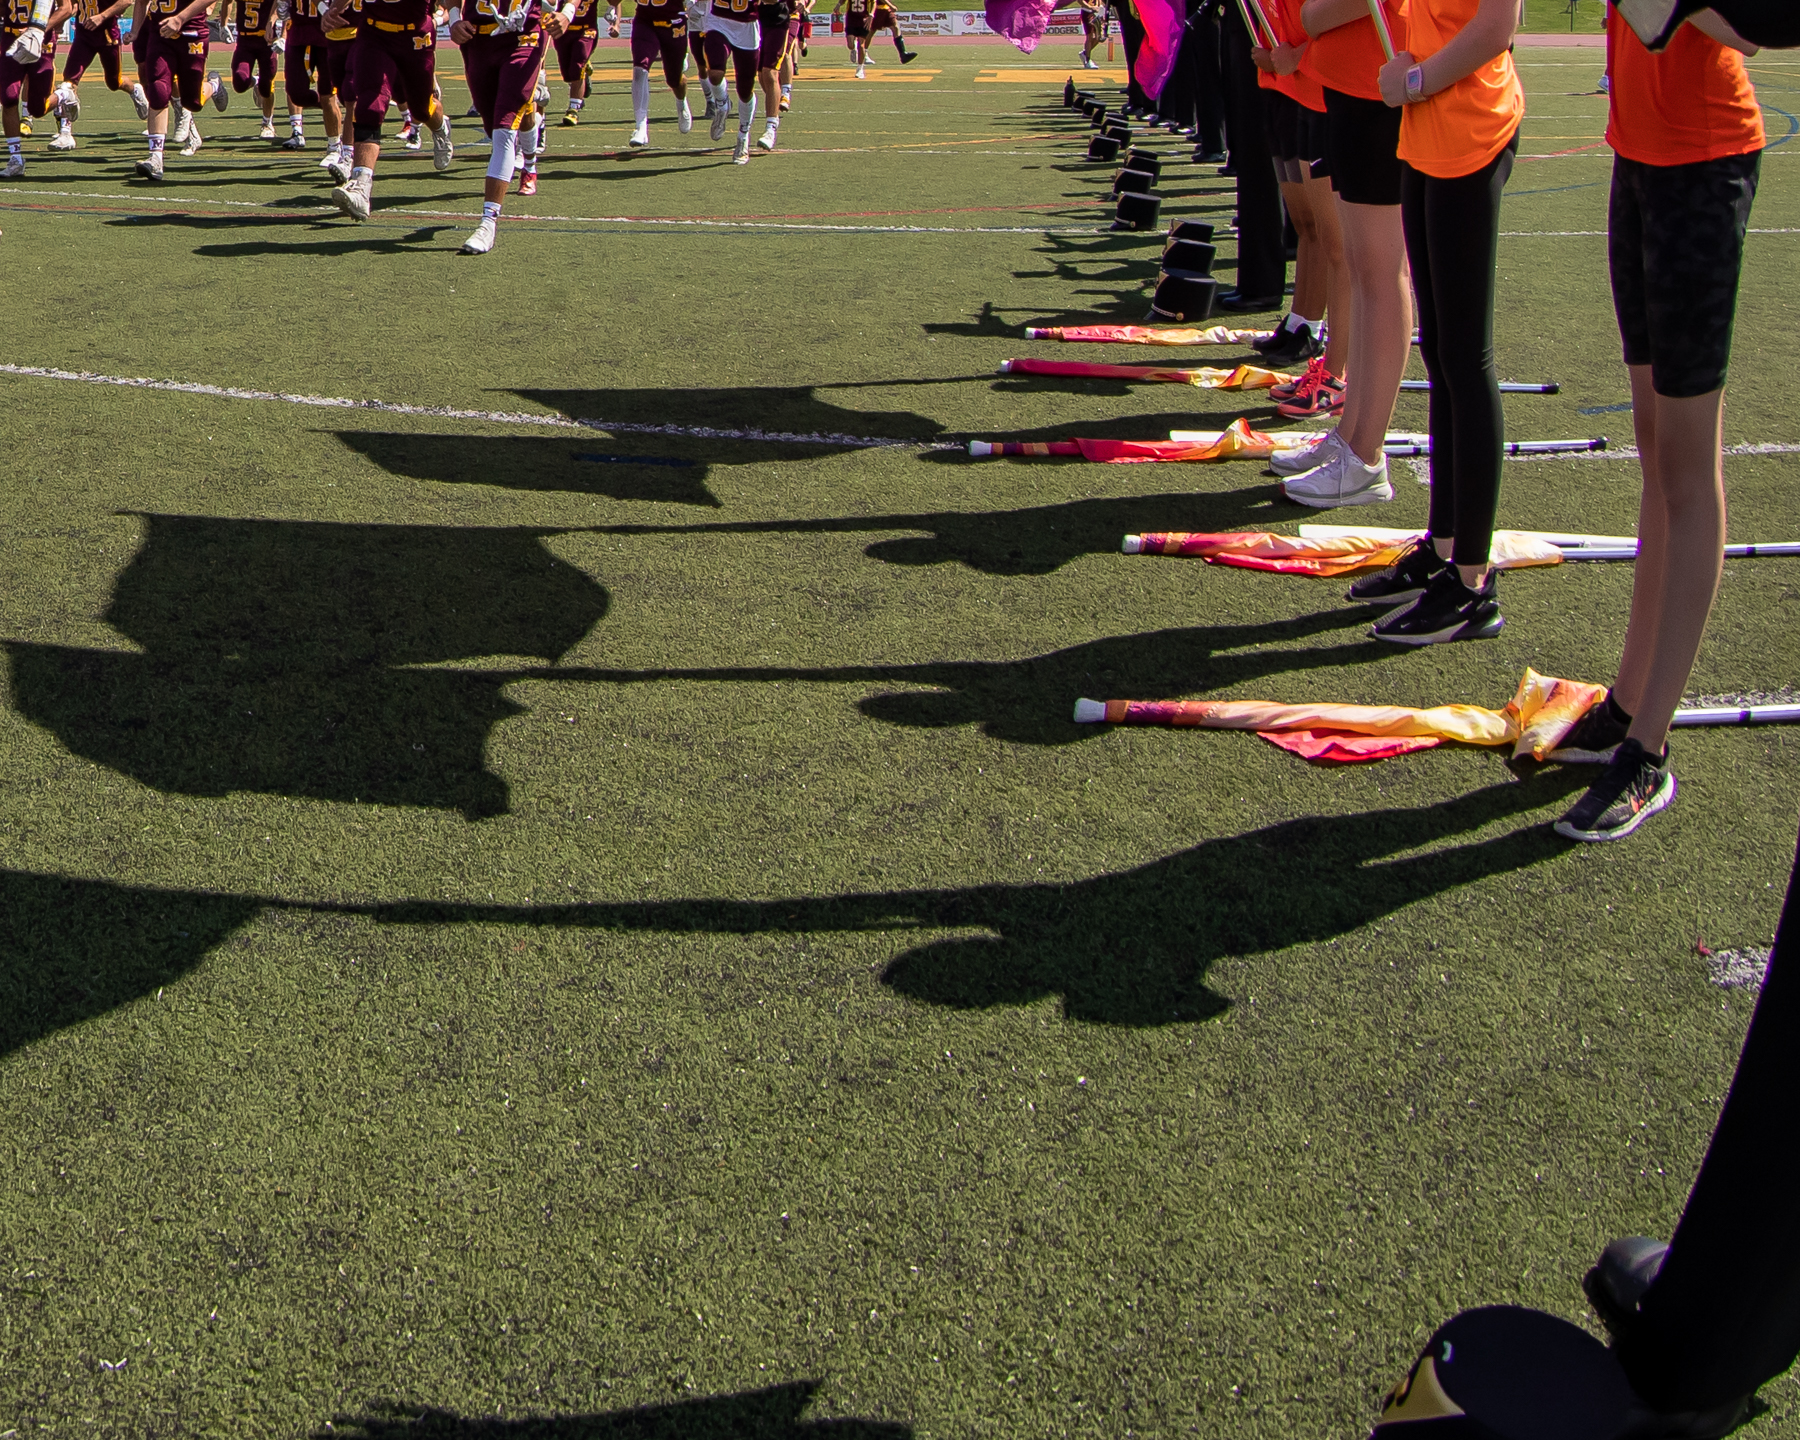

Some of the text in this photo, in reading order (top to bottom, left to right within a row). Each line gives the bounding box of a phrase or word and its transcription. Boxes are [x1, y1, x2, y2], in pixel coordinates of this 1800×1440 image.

[244, 2, 261, 29] 5
[1045, 26, 1079, 35] DODGERS
[188, 42, 204, 54] M
[412, 32, 432, 50] M
